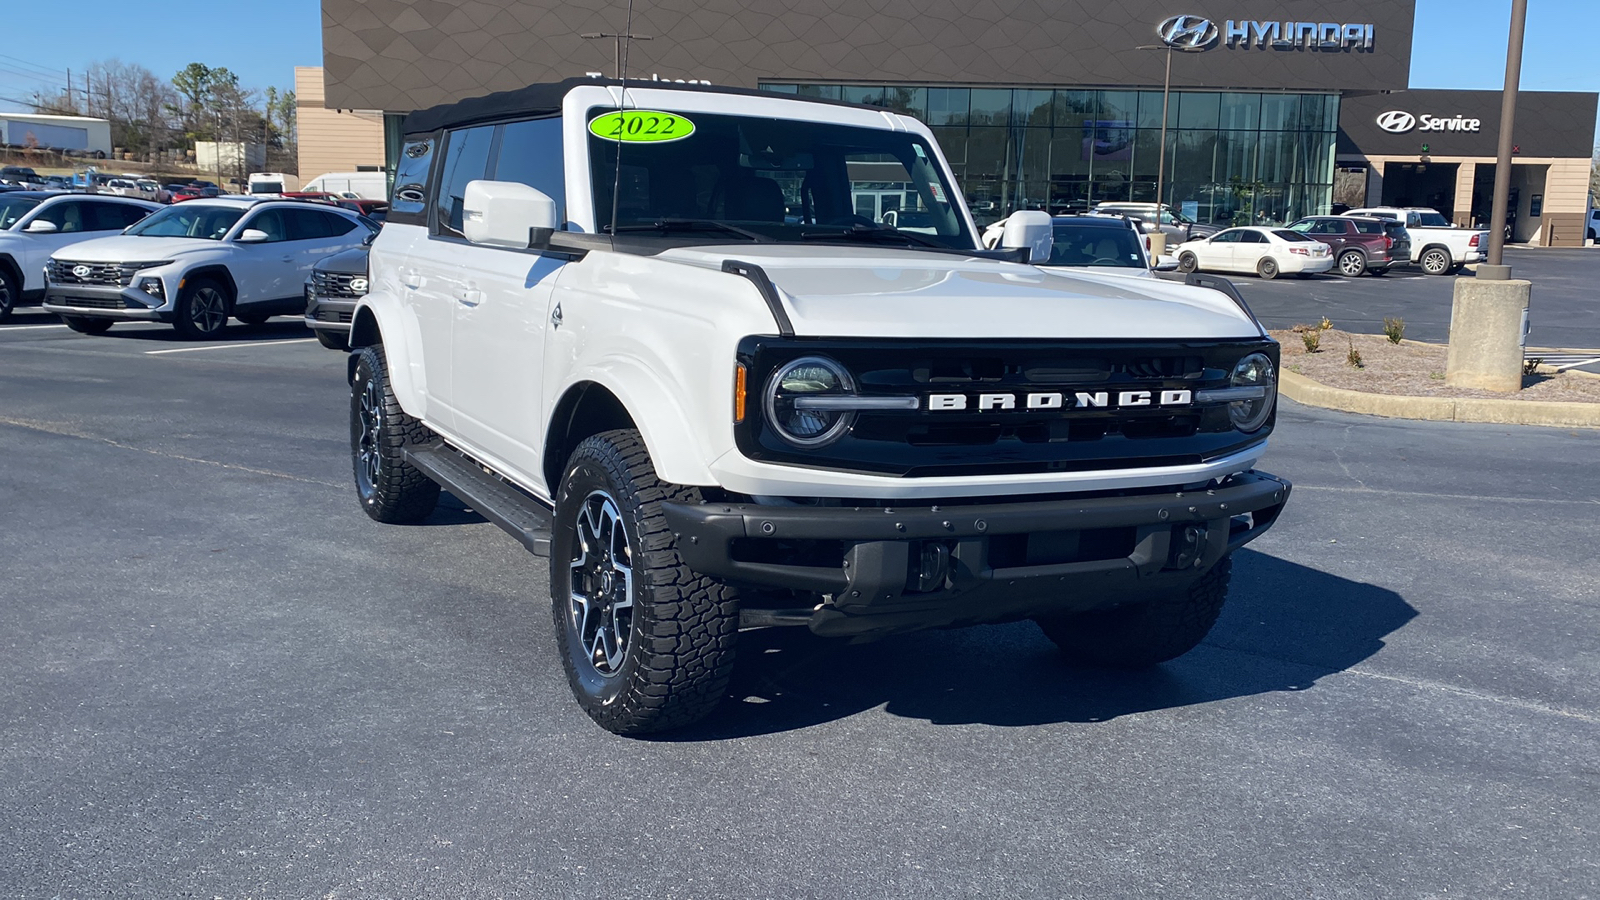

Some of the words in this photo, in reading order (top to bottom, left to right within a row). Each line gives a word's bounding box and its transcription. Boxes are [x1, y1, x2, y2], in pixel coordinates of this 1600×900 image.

[1224, 19, 1374, 49] HYUNDAI
[609, 116, 676, 136] 2022
[1419, 114, 1481, 131] Service
[929, 390, 1192, 411] BRONCO
